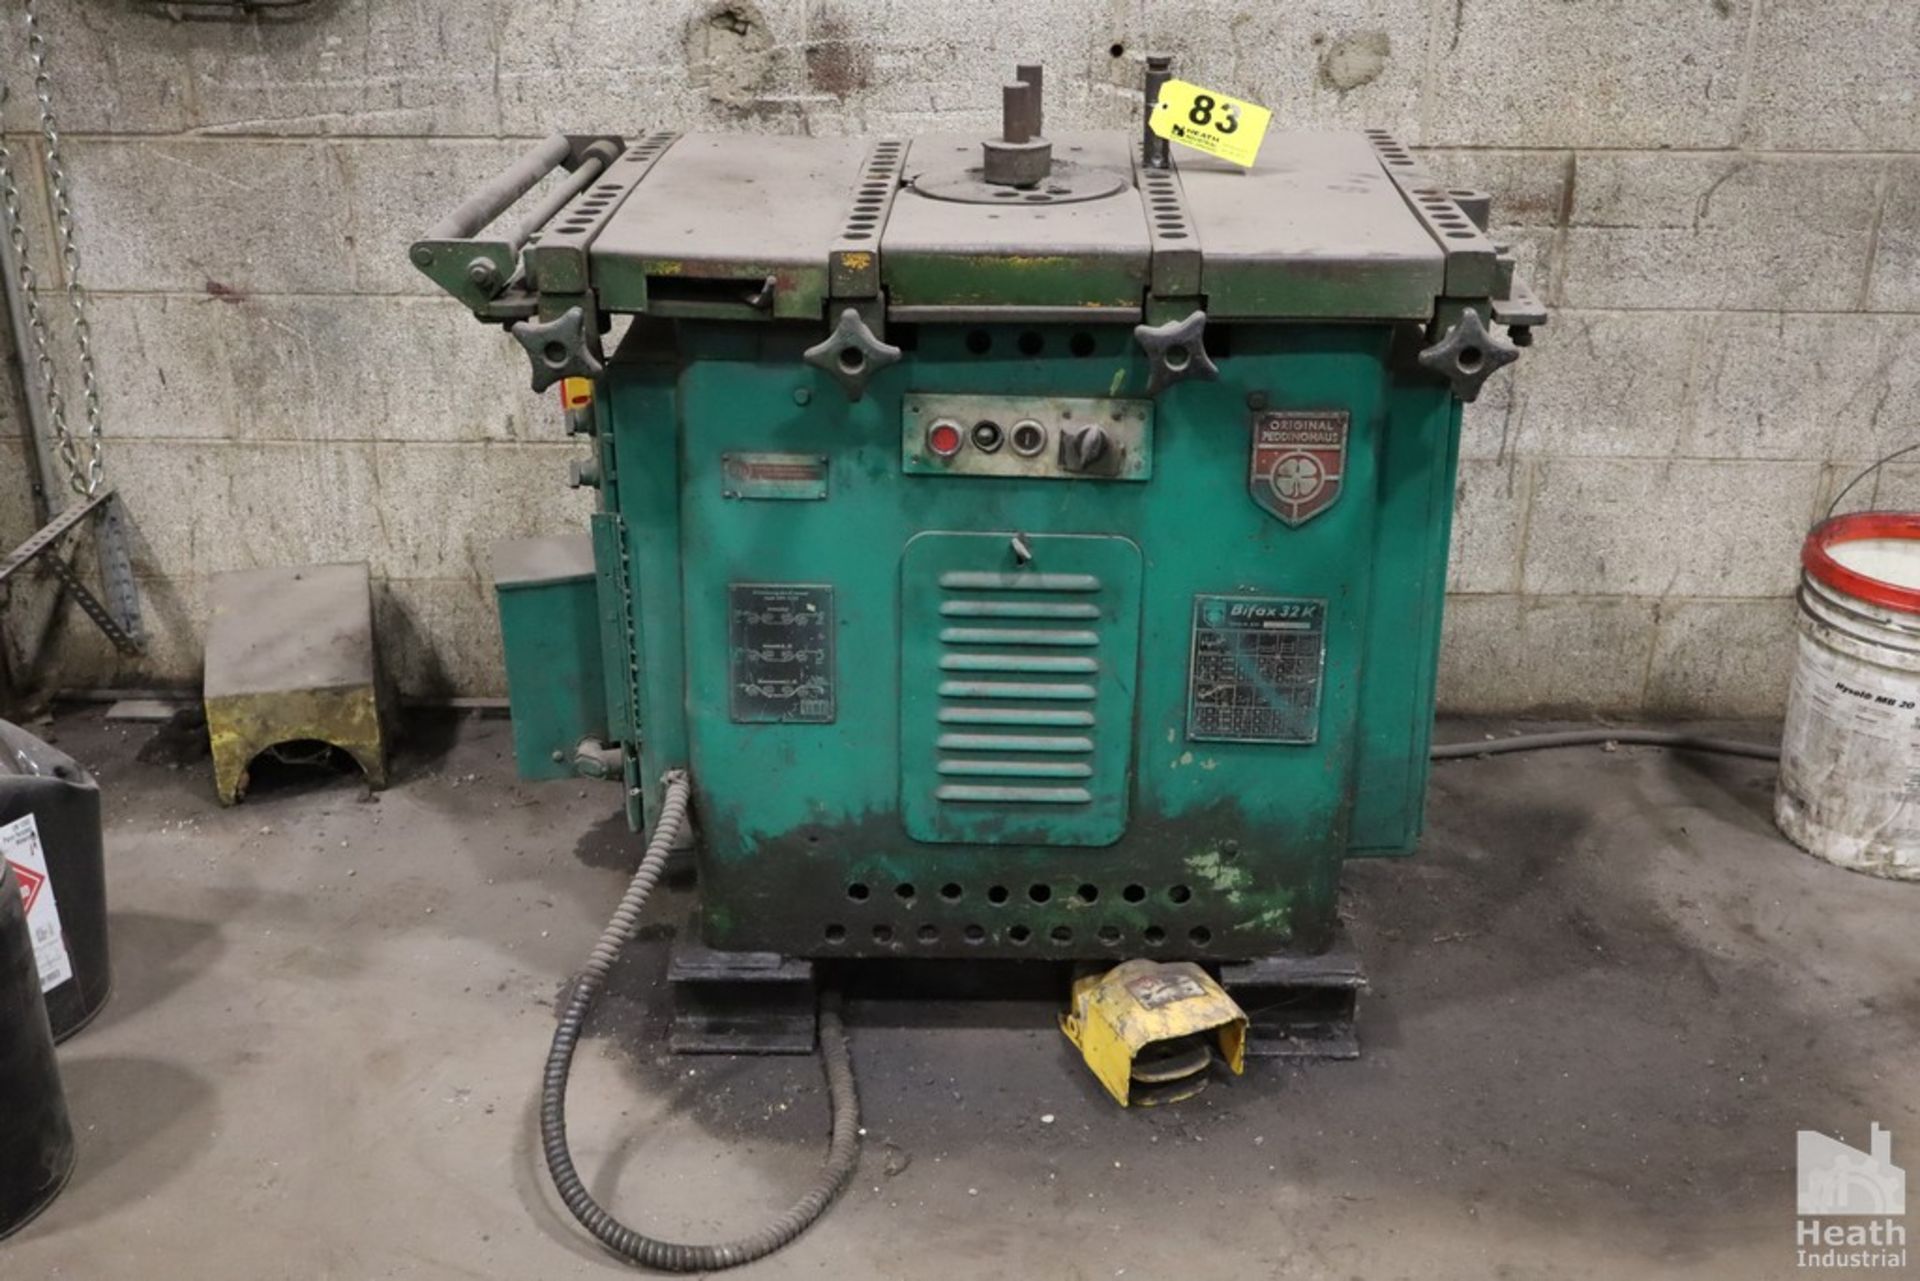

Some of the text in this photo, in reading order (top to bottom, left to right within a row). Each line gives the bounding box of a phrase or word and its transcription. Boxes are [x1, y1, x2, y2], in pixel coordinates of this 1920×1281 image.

[1188, 94, 1242, 134] 83
[1270, 420, 1334, 431] ORIGINAL
[1230, 603, 1277, 619] Bifax
[1874, 695, 1897, 706] MB
[1899, 700, 1916, 709] 20
